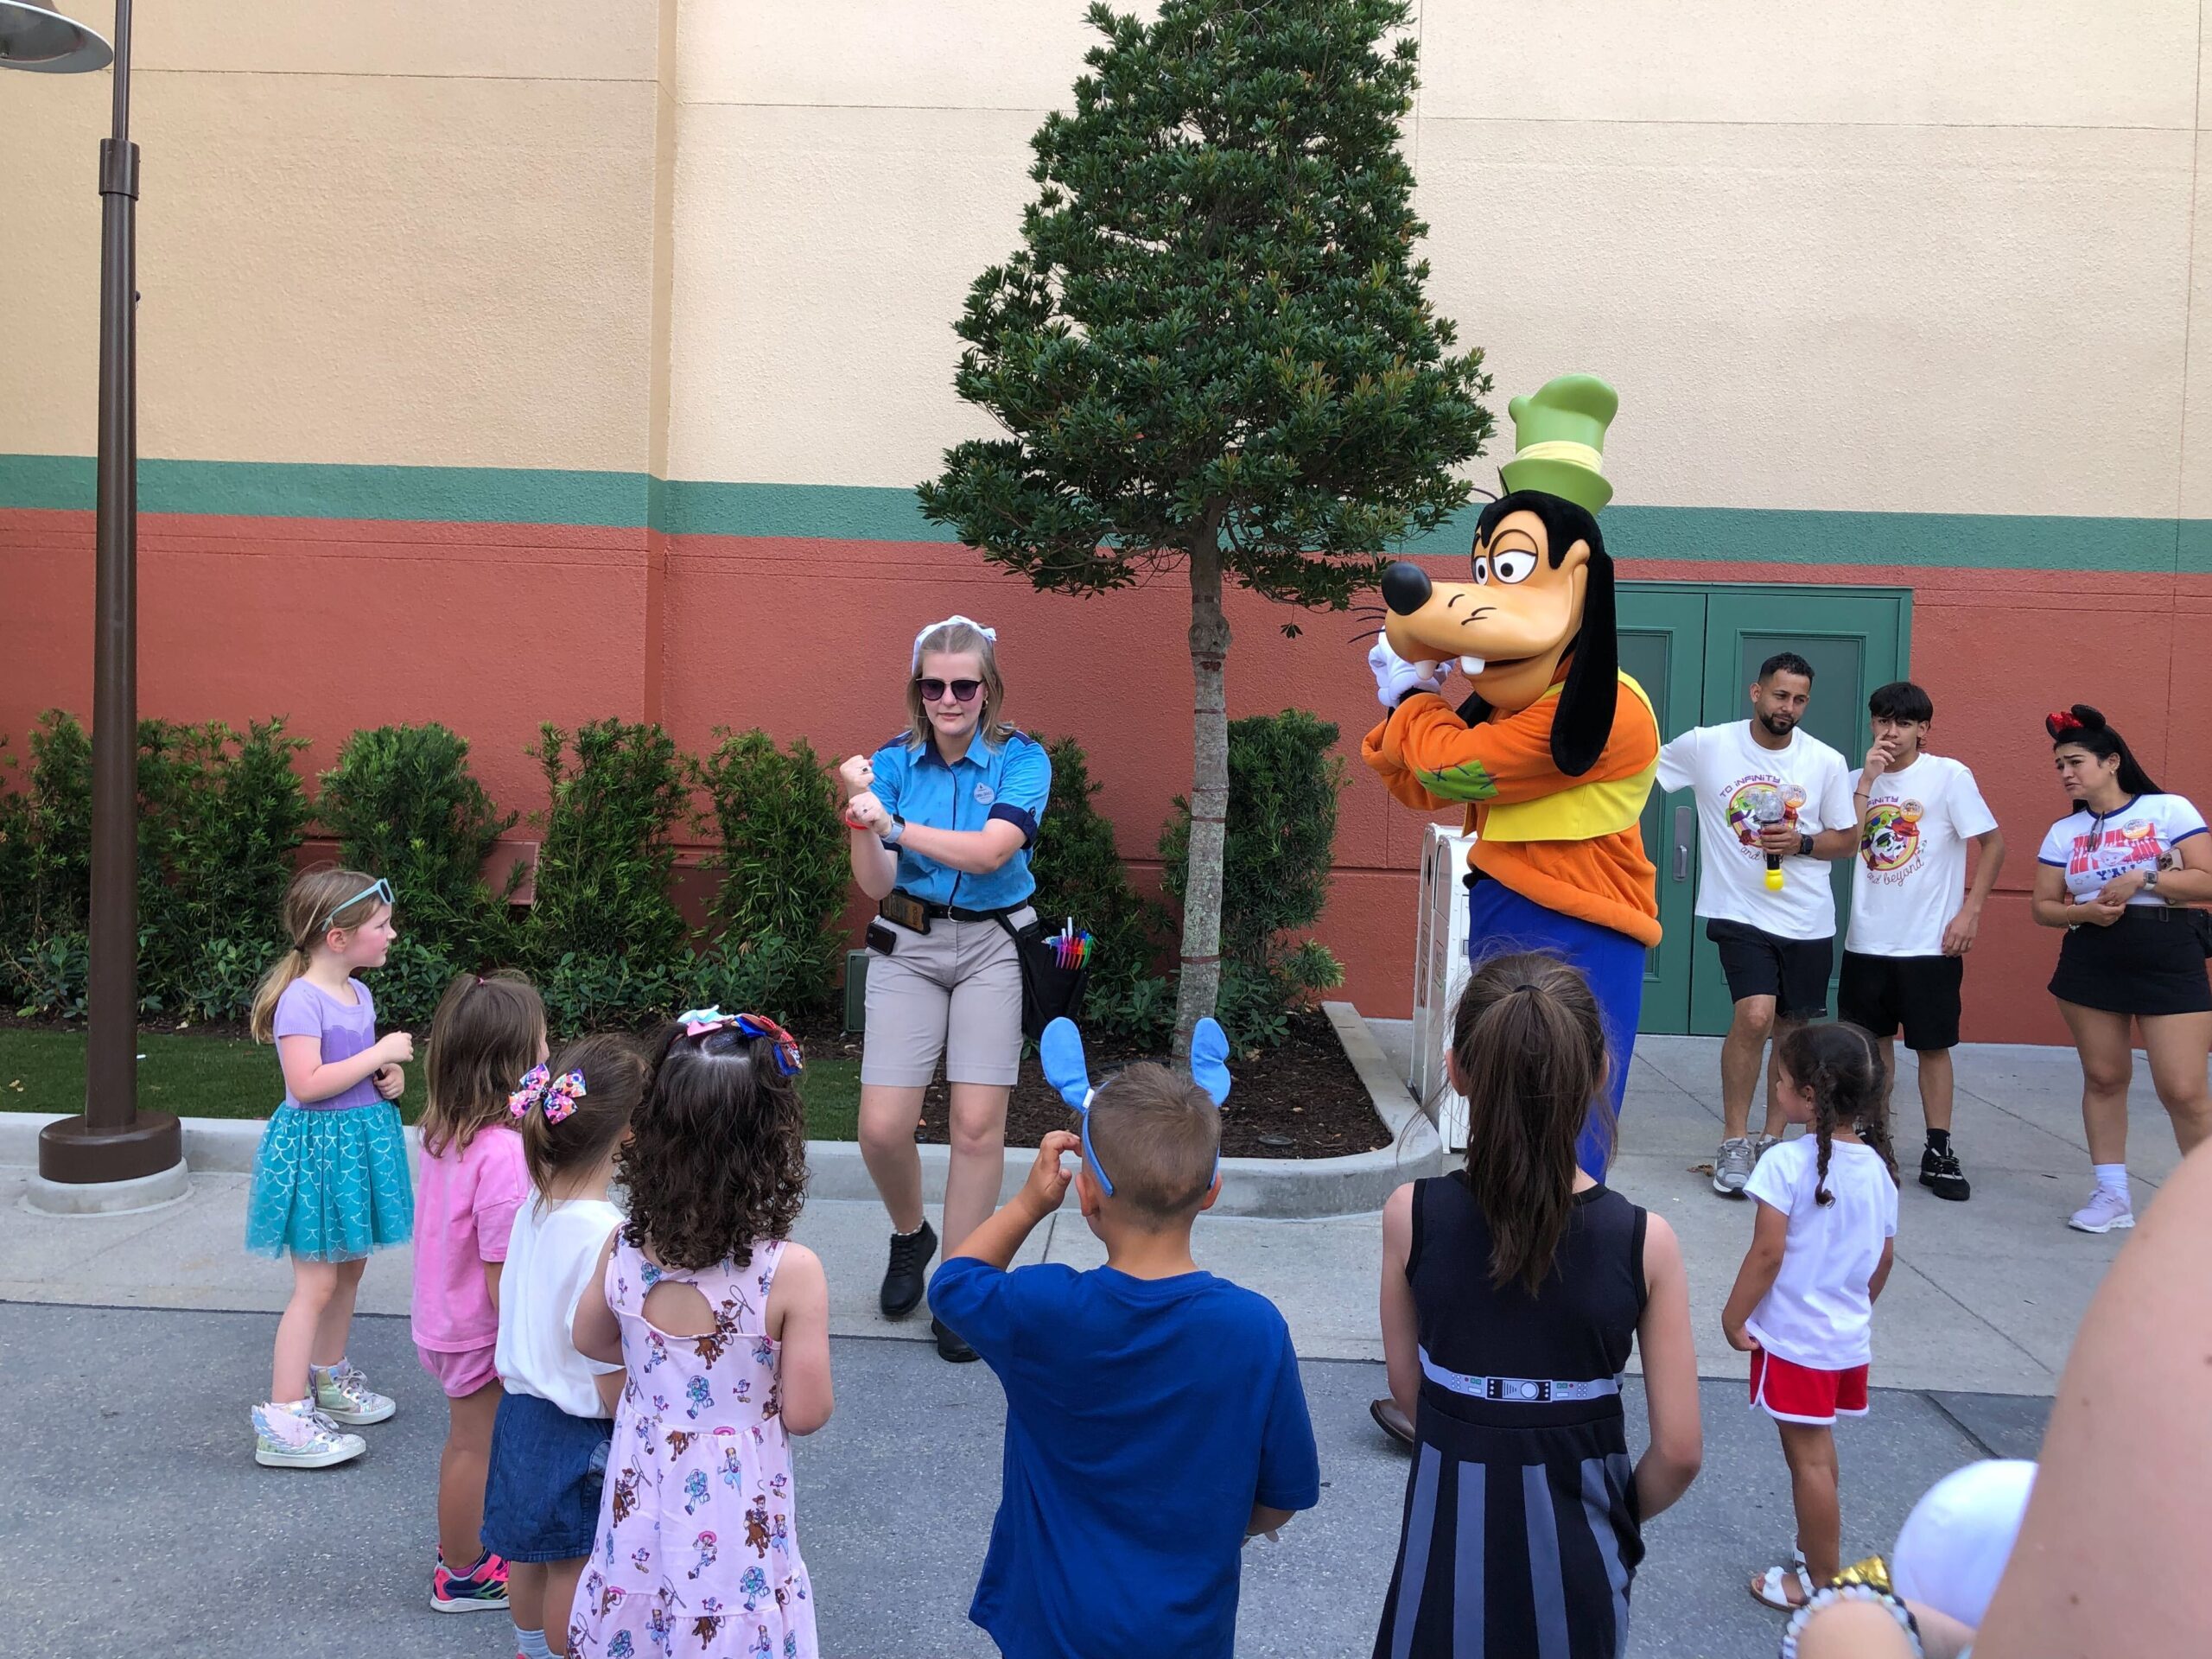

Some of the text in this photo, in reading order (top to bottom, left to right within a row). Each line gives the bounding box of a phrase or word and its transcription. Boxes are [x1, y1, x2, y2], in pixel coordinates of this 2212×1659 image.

[1719, 785, 1733, 798] TO
[1740, 846, 1760, 861] and
[1867, 855, 1924, 887] and beyond
